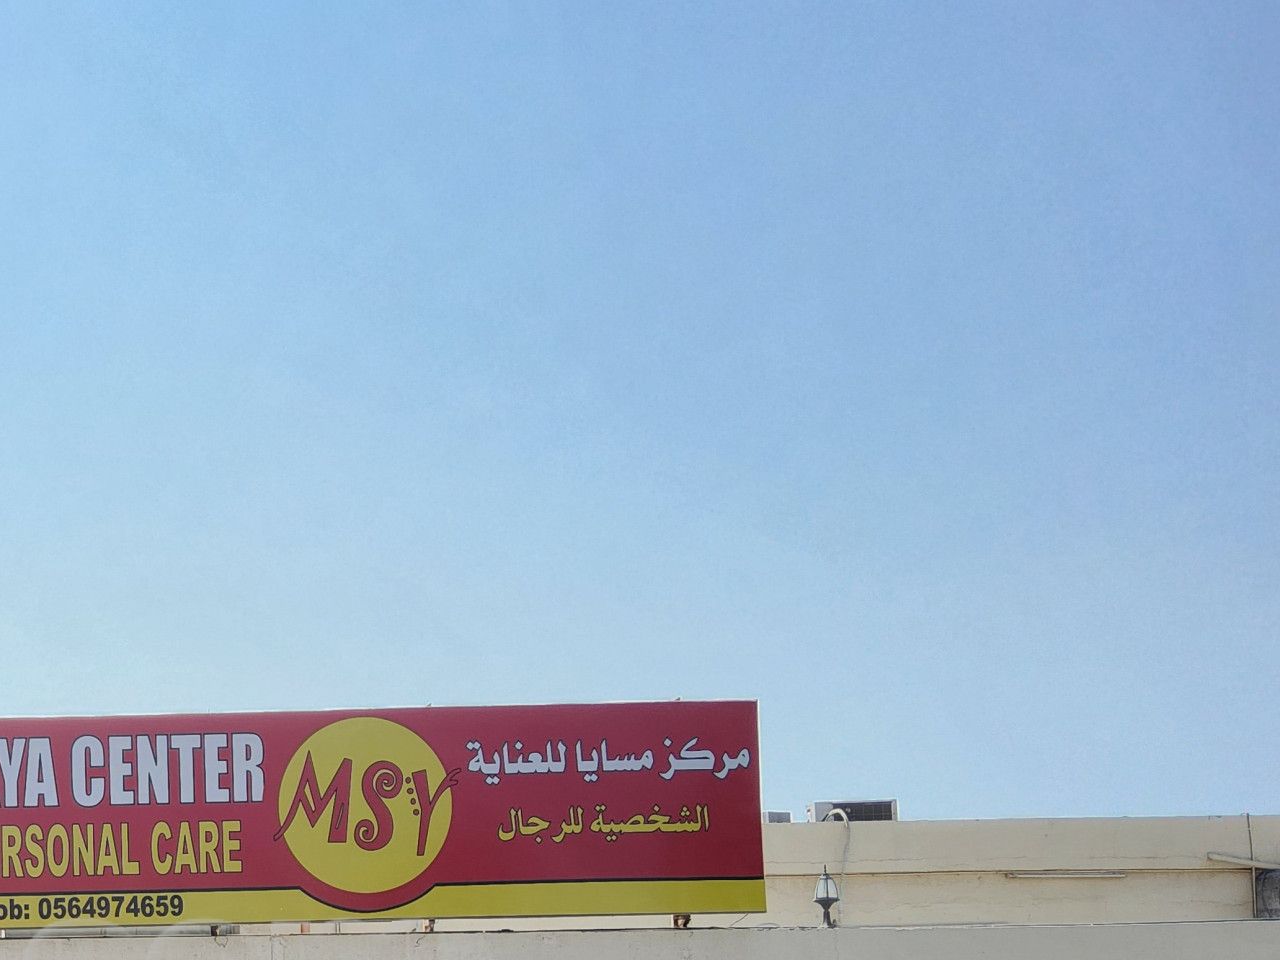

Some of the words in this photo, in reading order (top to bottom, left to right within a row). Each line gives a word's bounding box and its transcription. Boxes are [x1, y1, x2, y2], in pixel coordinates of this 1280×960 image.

[70, 732, 265, 807] CENTER
[465, 739, 567, 786] للعناية
[575, 738, 654, 782] مسايا
[659, 737, 751, 780] مركز
[496, 806, 585, 844] للرجال
[590, 803, 710, 844] الشخصية
[150, 820, 244, 875] CARE
[38, 895, 185, 920] 0564974659
